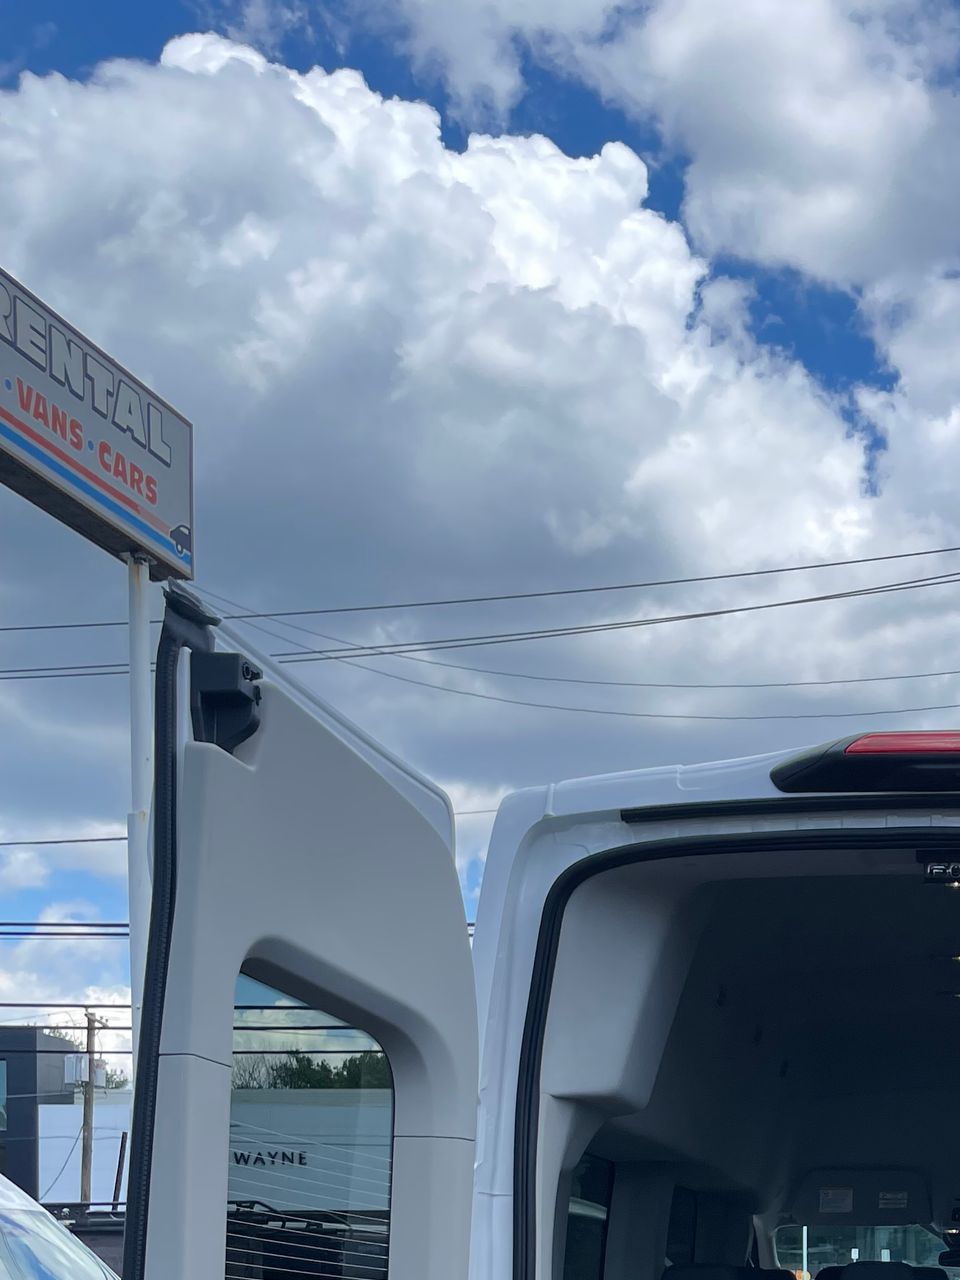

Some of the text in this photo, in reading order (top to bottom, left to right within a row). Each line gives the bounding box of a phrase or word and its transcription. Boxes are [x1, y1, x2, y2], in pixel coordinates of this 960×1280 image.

[16, 377, 158, 505] VANS CARS
[233, 1151, 308, 1166] WAYNE
